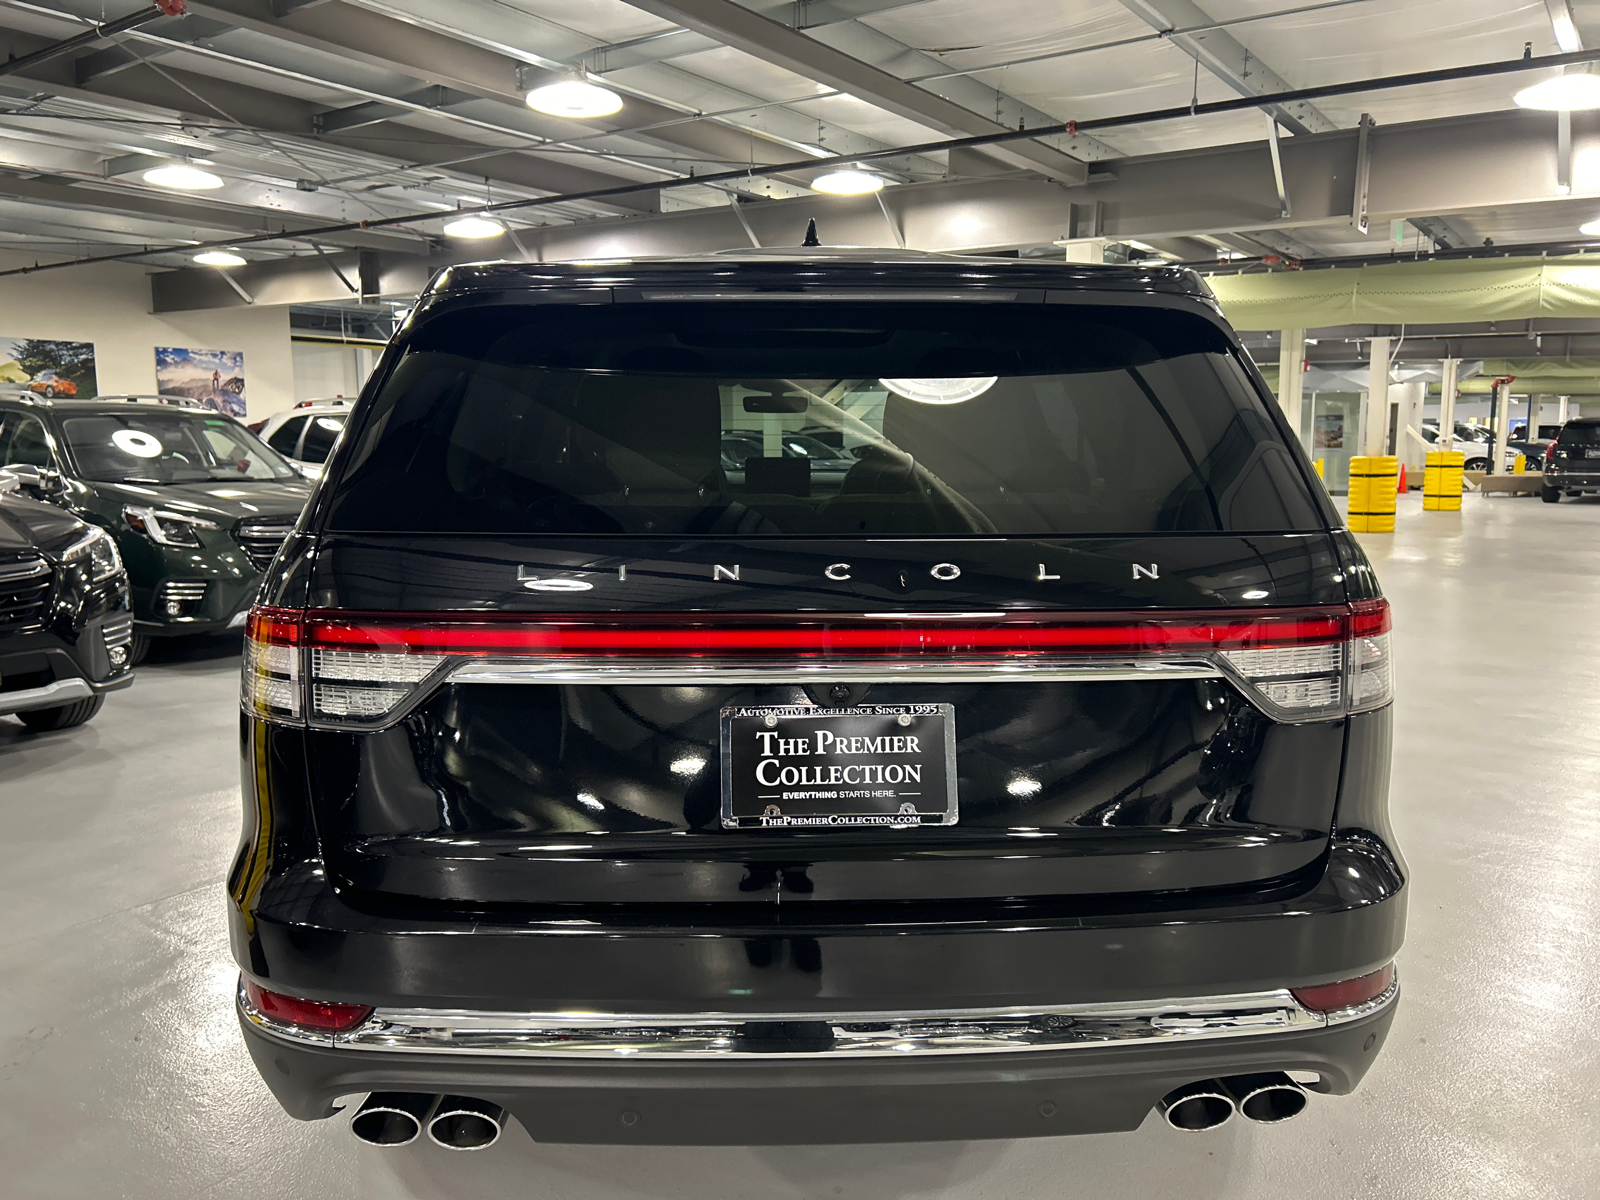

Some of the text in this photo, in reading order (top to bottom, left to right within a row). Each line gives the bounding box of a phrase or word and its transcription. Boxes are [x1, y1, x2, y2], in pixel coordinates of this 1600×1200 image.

[516, 562, 1161, 582] LINCOLN
[874, 705, 906, 715] SINCE
[908, 704, 938, 715] 1995
[755, 729, 922, 757] THE PREMIER
[755, 758, 923, 787] COLLECTION
[782, 789, 897, 800] EVERYTHING STARTS HERE.
